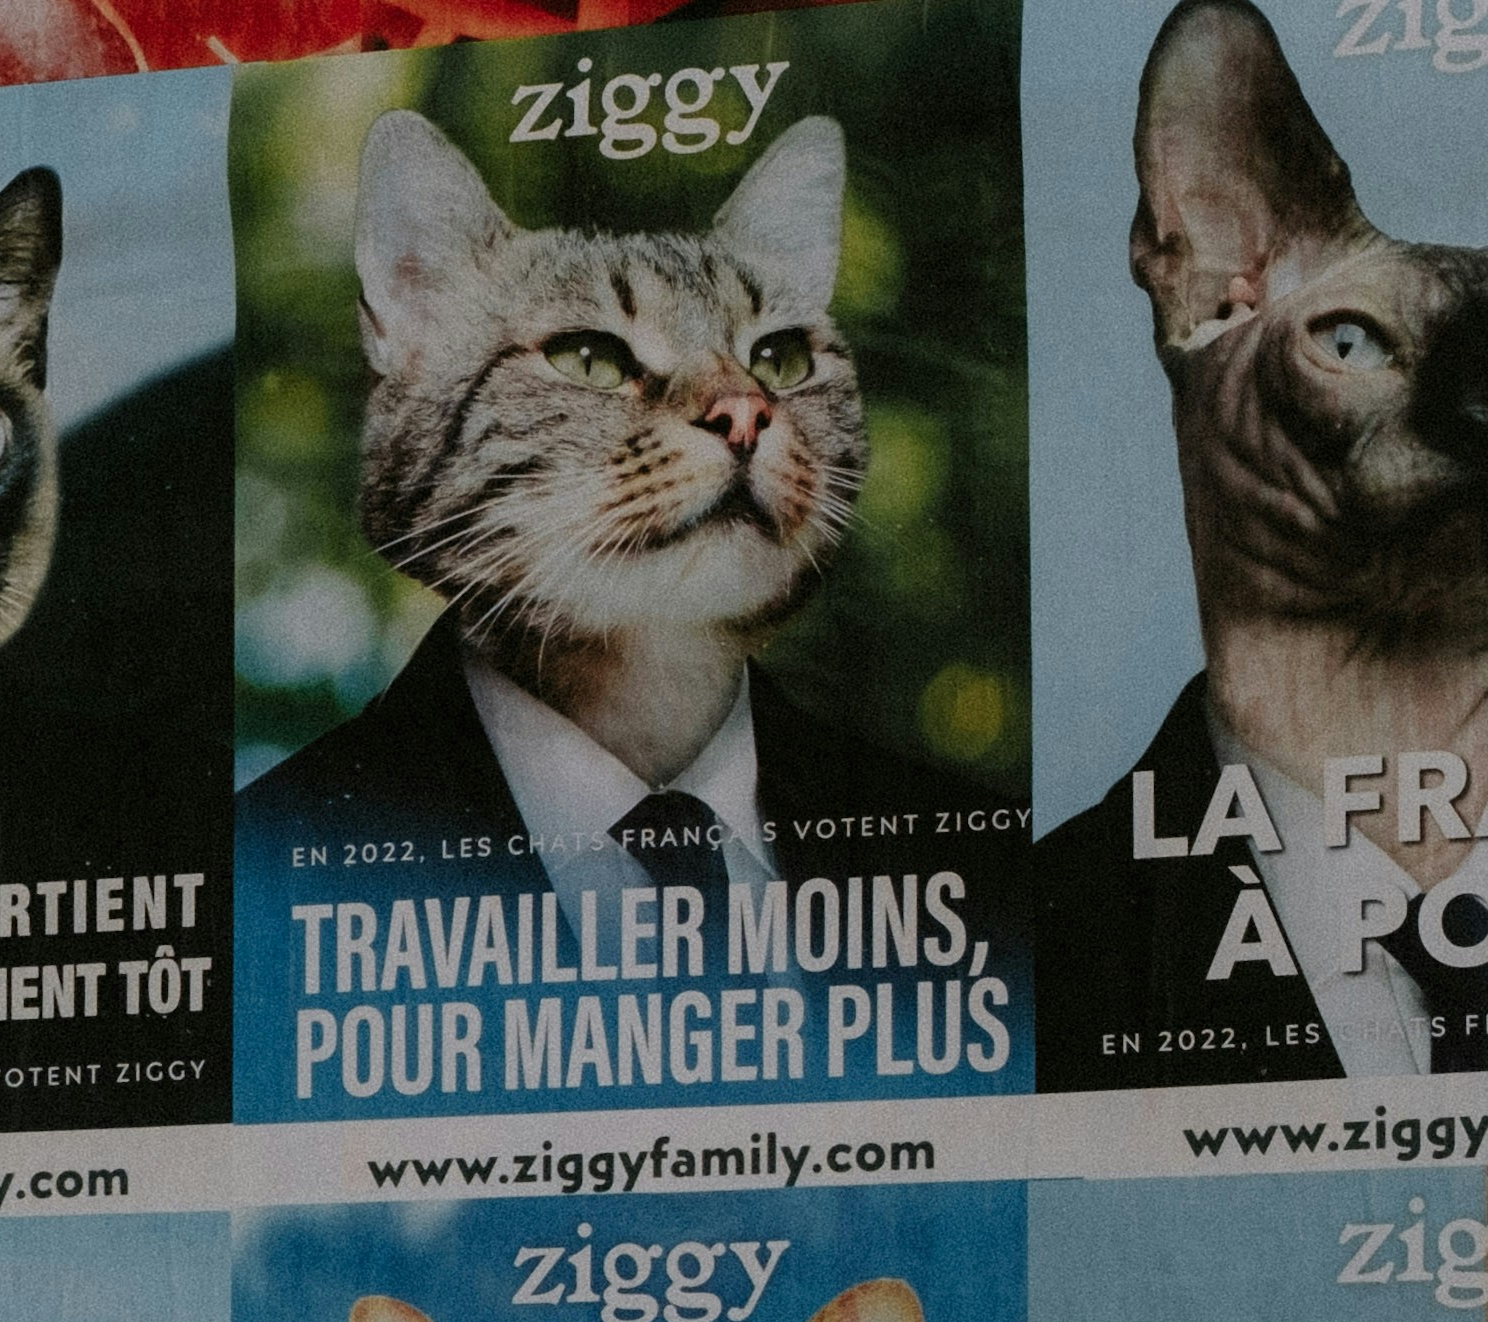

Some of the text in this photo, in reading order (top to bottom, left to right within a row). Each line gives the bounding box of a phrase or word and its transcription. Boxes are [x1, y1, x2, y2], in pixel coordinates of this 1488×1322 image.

[508, 56, 791, 161] ziggy
[291, 808, 1033, 869] EN 2022, LES CHATS FRANÇAIS VOTENT ZIGGY
[1132, 763, 1283, 860] LA
[291, 870, 990, 995] TRAVAILLER MOINS,
[1205, 865, 1299, 981] À
[118, 945, 213, 1015] TÔT
[116, 1059, 207, 1084] ZIGGY
[295, 976, 1011, 1100] POUR MANGER PLUS
[367, 1131, 936, 1194] www.ziggyfamily.com
